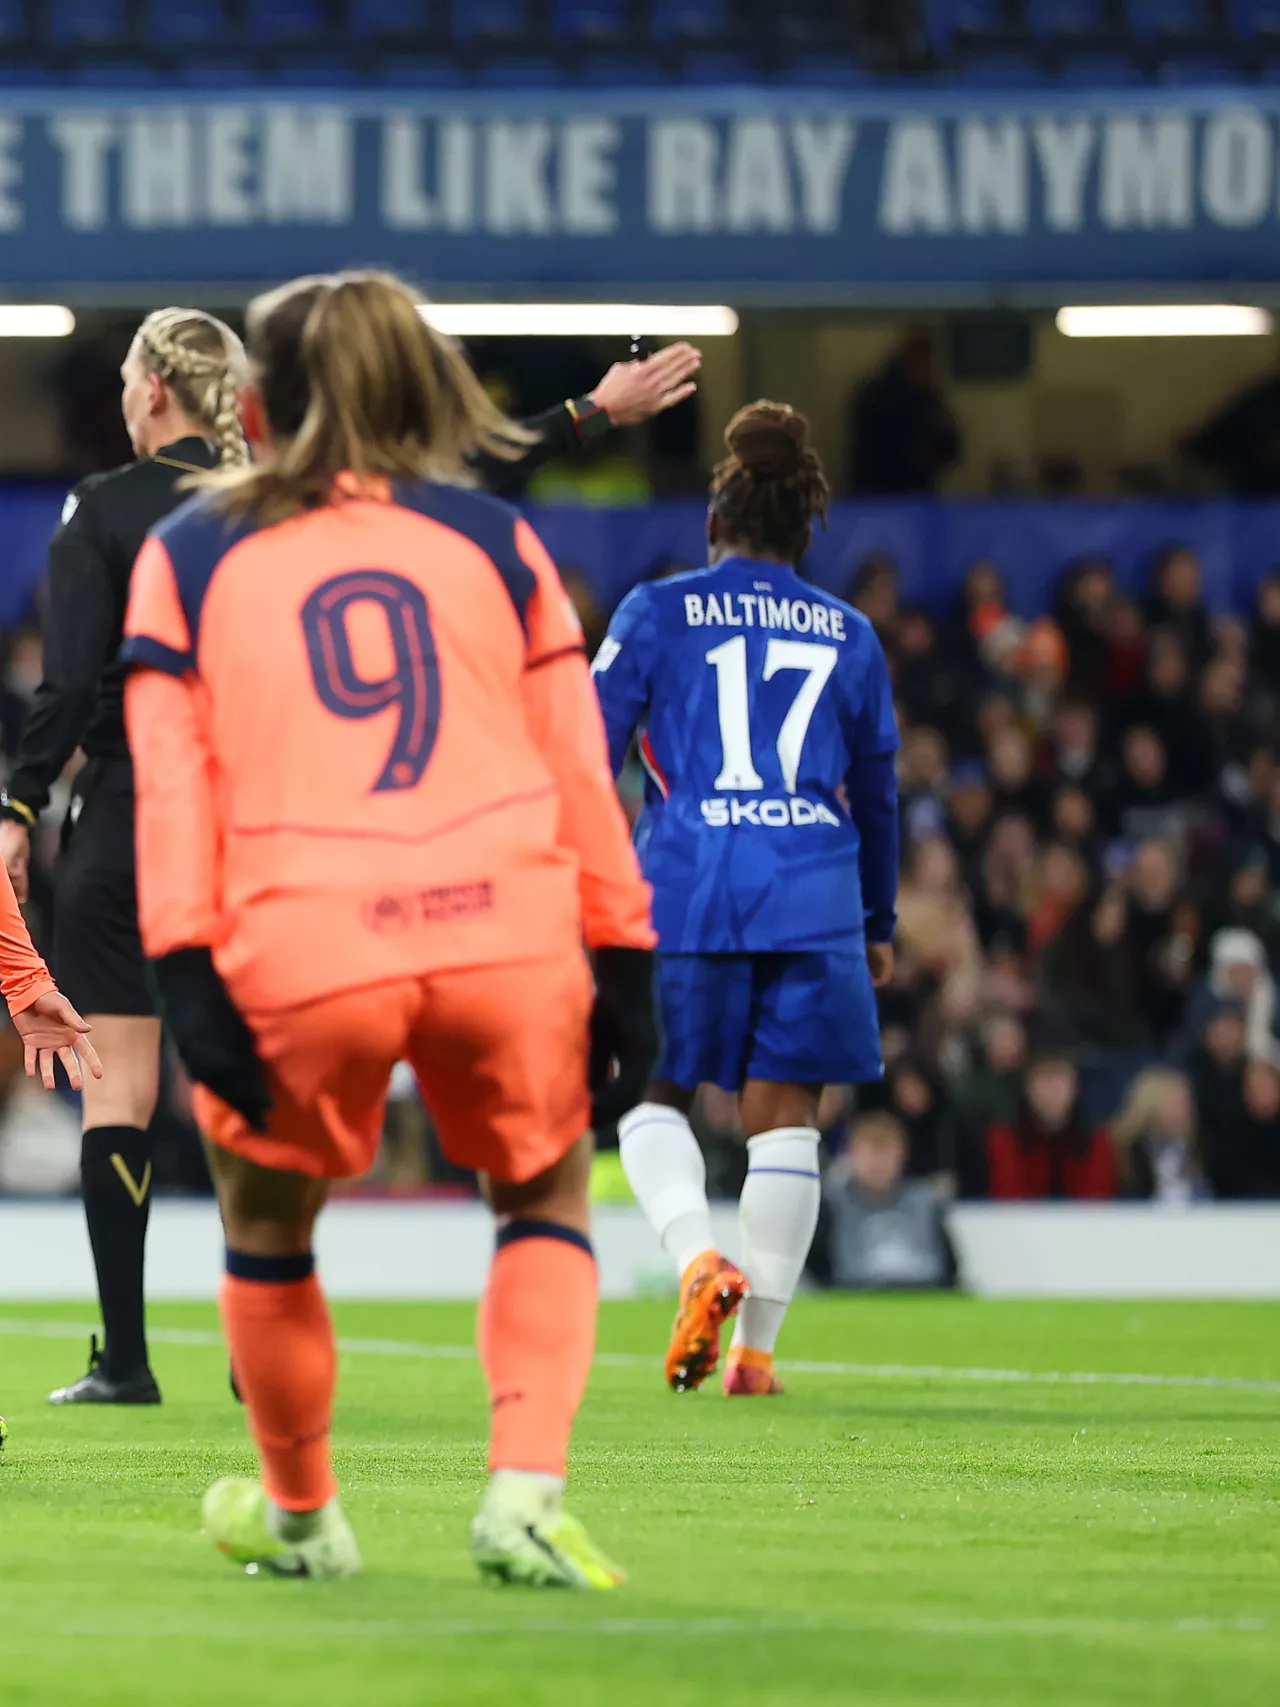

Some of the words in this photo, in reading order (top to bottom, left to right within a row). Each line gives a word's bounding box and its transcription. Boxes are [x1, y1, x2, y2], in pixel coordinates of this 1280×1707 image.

[52, 102, 350, 227] THEM
[384, 107, 617, 233] LIKE
[647, 112, 854, 233] RAY
[880, 104, 1280, 234] ANYMO
[300, 570, 442, 793] 9
[683, 591, 847, 642] BALTIMORE
[705, 634, 839, 796] 17
